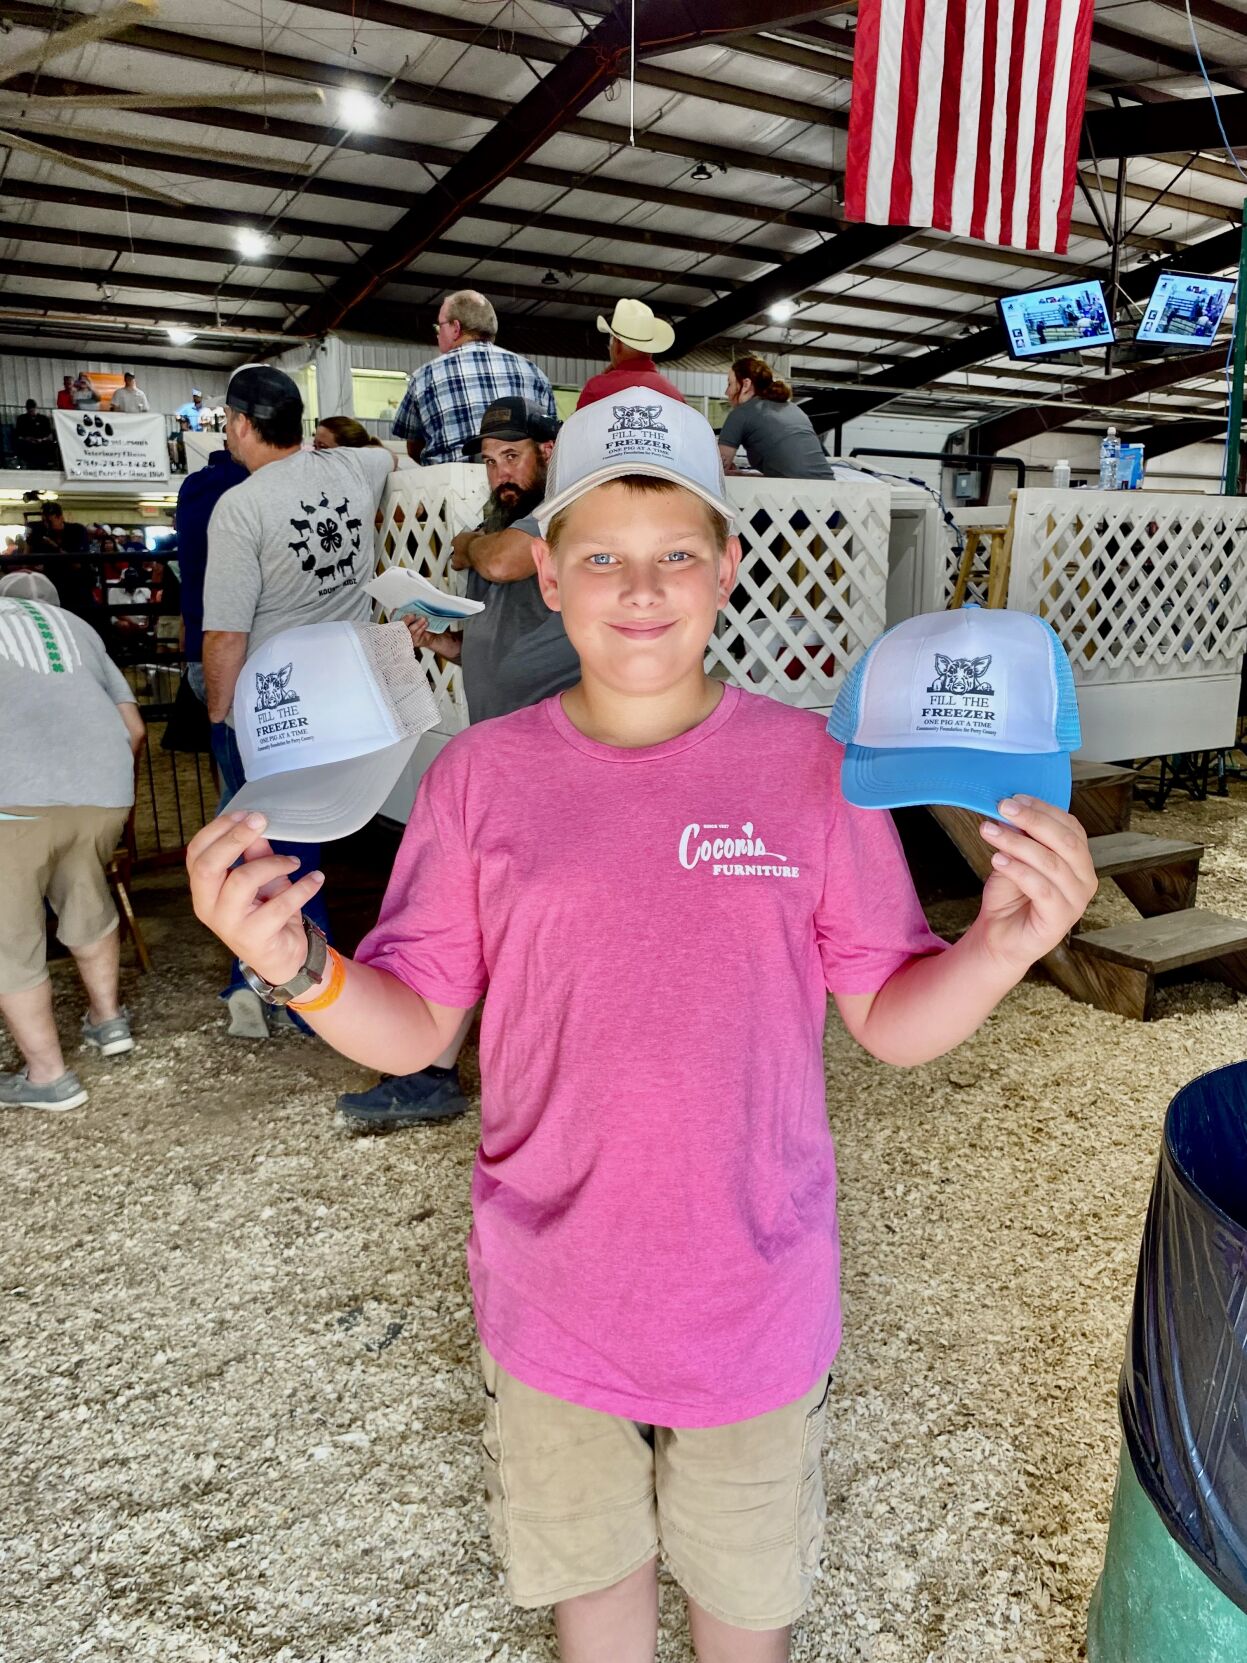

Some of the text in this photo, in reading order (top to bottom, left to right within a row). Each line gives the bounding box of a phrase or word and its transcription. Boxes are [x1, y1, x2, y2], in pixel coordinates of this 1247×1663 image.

[612, 431, 665, 440] FILL THE
[605, 438, 672, 452] FREEZER
[608, 446, 622, 455] ONE
[931, 695, 989, 707] FILL THE
[257, 705, 299, 724] FILL THE
[921, 708, 996, 721] FREEZER
[256, 717, 309, 737] FREEZER
[973, 721, 992, 729] TIME
[269, 735, 278, 743] PIG
[278, 732, 286, 740] AT
[291, 729, 308, 737] TIME
[713, 864, 799, 878] FURNITURE
